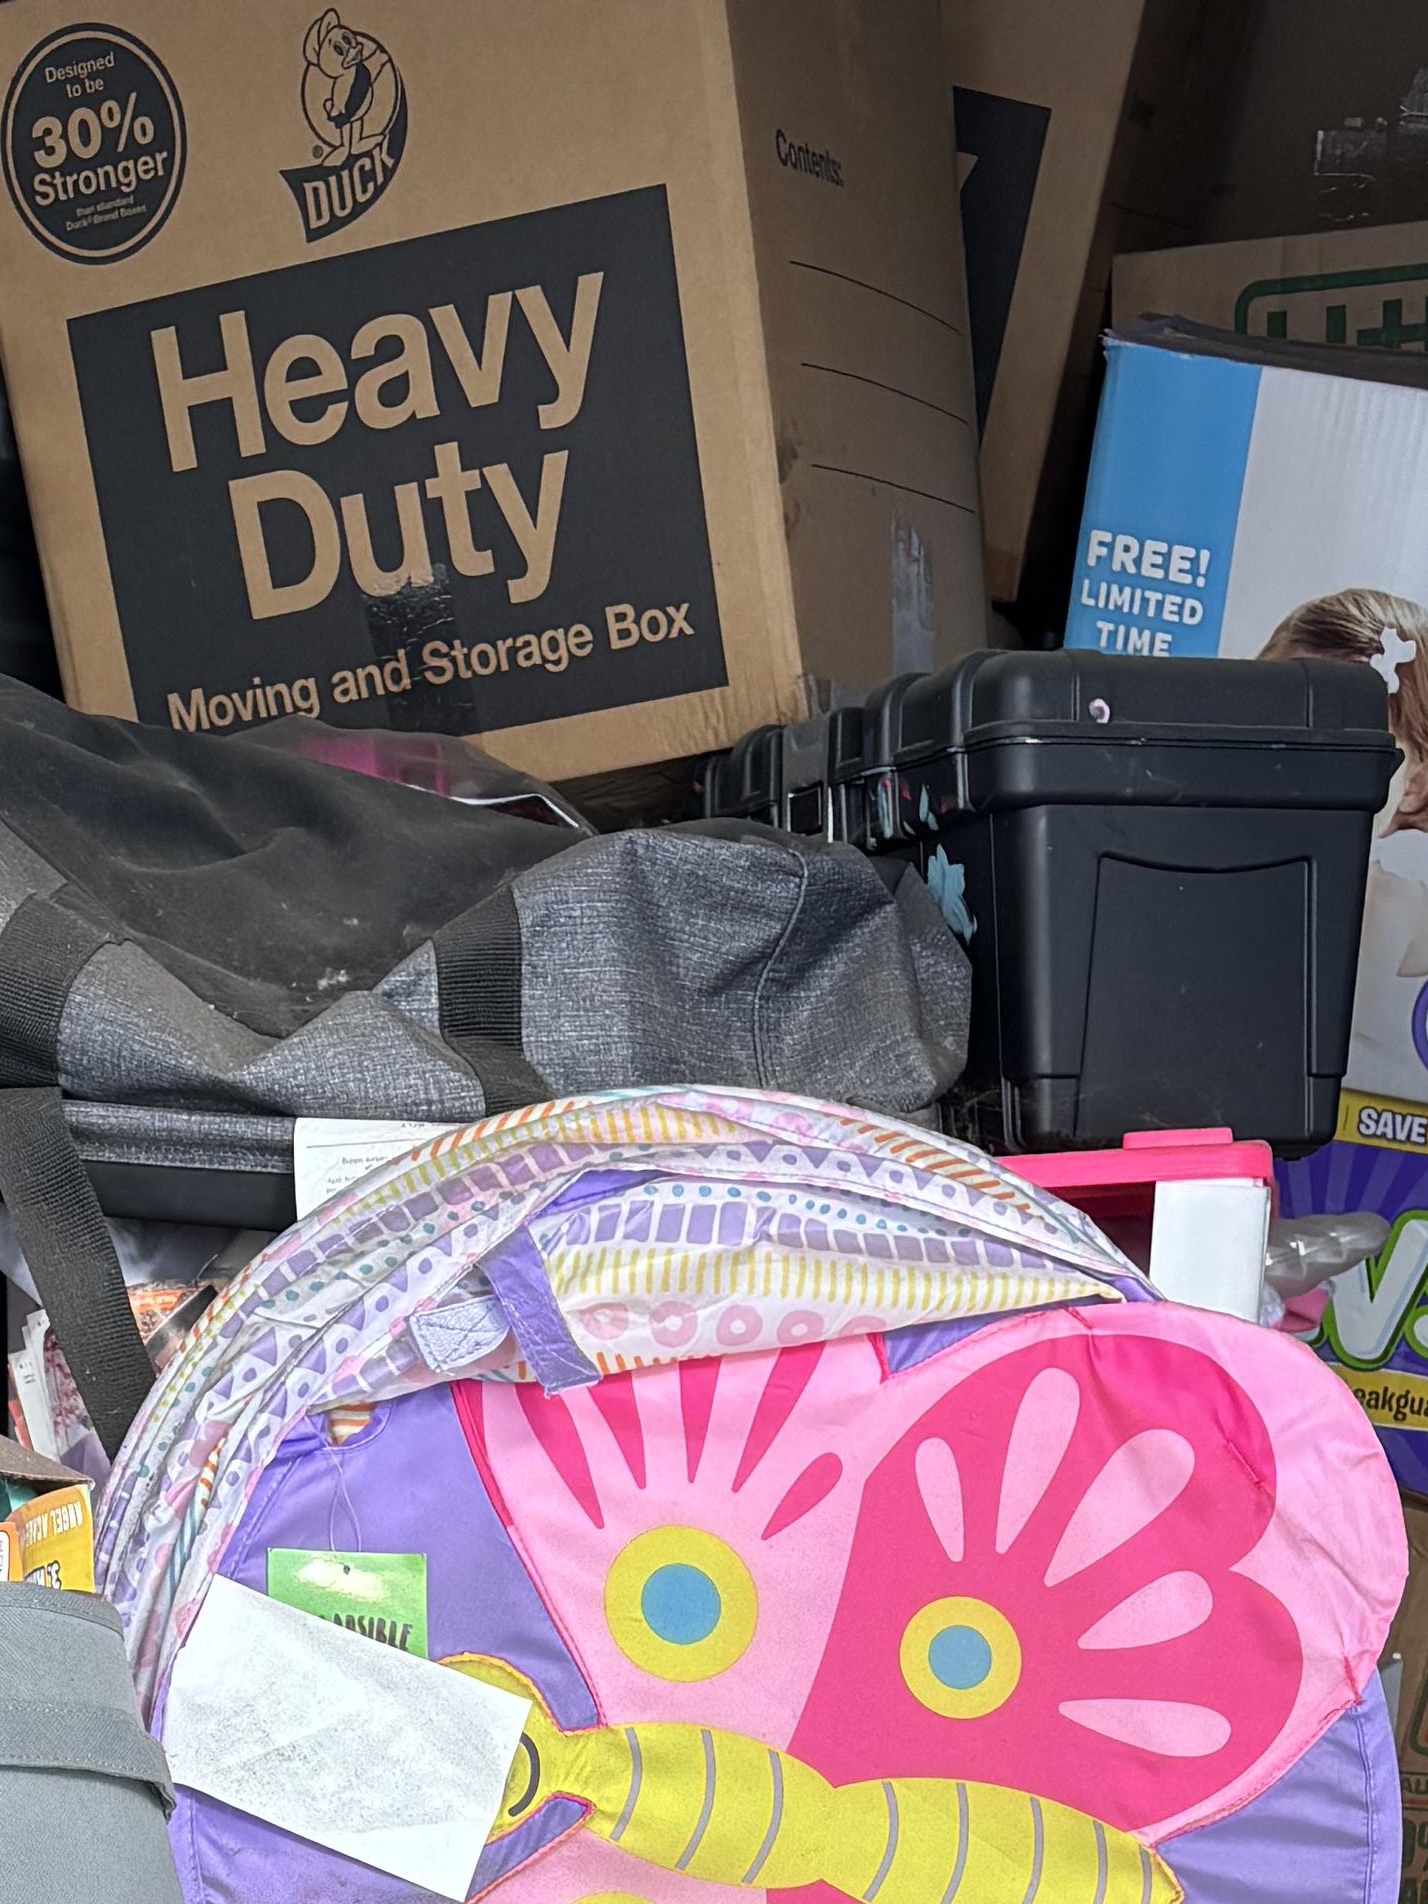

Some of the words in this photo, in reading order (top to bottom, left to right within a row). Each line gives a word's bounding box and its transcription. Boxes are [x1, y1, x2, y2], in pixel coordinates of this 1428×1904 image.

[45, 52, 116, 83] Designed
[66, 82, 83, 98] to
[85, 78, 104, 95] be
[31, 92, 155, 168] 30%
[775, 127, 844, 188] Contents:
[33, 149, 168, 206] Stronger
[303, 138, 395, 230] DUCK
[150, 271, 604, 472] Heavy
[228, 441, 570, 621] Duty
[1086, 530, 1210, 588] FREE!
[1080, 579, 1205, 627] LIMITED
[167, 675, 320, 733] Moving
[331, 652, 410, 704] and
[420, 623, 593, 686] Storage
[604, 600, 696, 650] Box
[1095, 620, 1174, 658] TIME
[1358, 1107, 1427, 1144] SAVE
